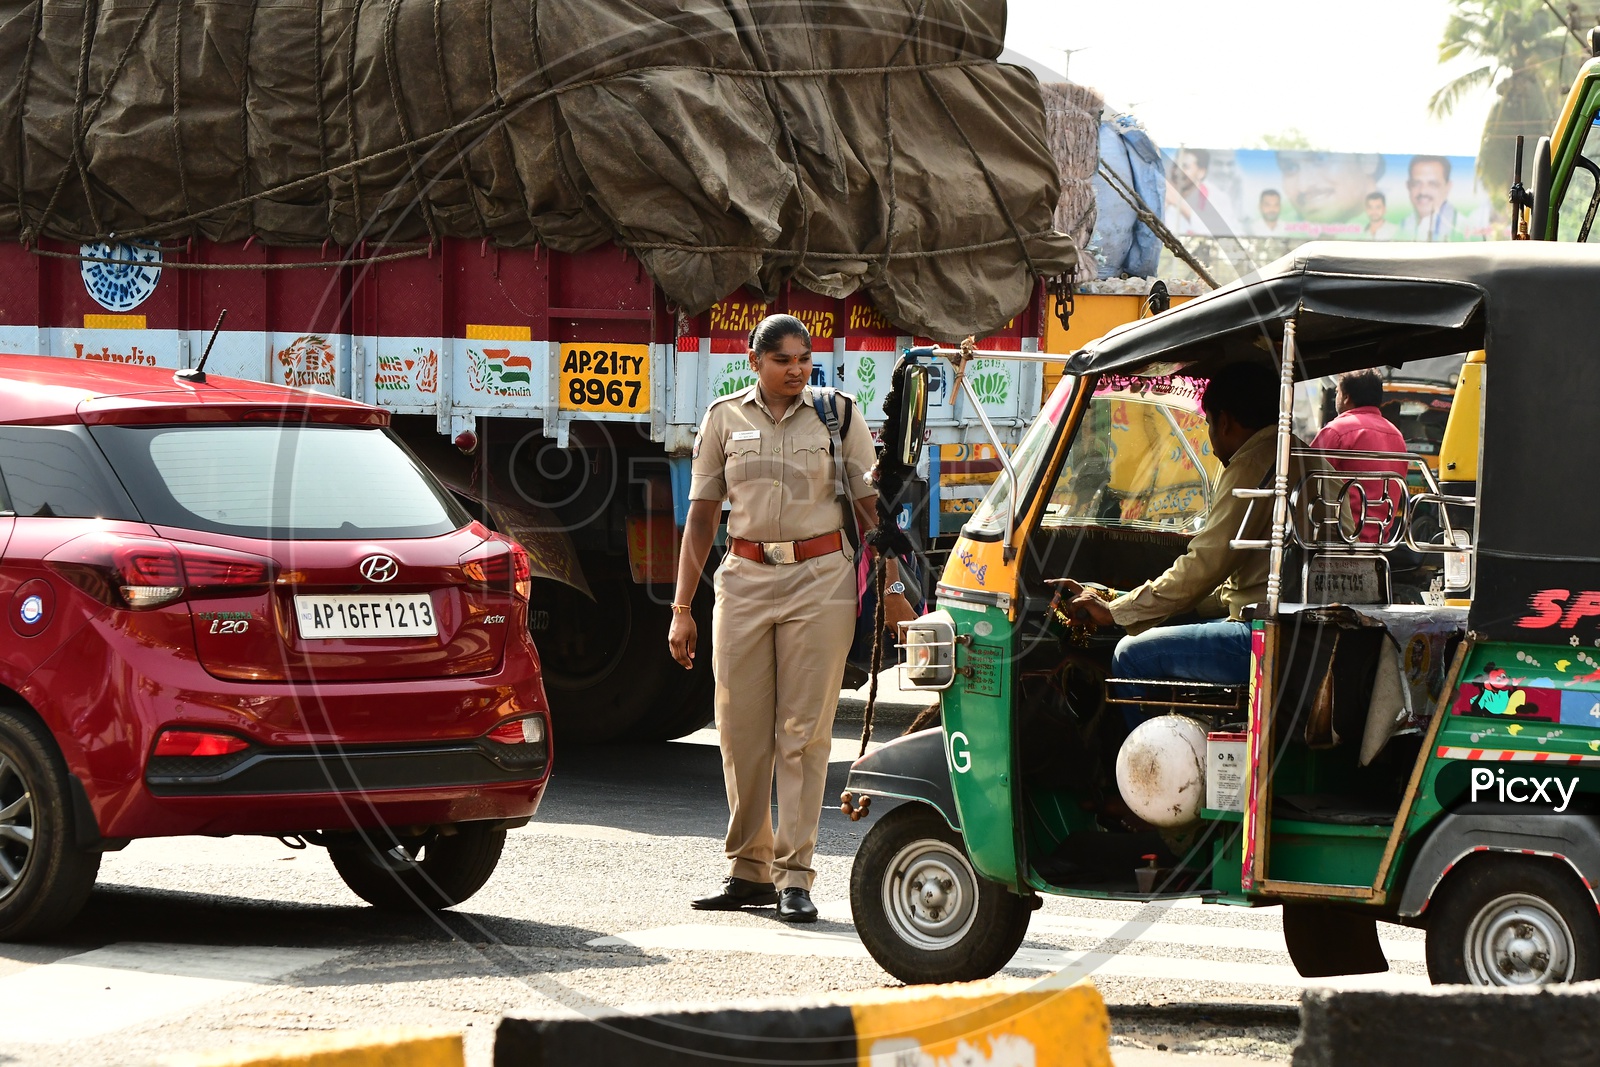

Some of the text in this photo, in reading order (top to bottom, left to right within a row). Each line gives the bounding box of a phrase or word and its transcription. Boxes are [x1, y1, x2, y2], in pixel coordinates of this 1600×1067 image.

[787, 309, 834, 339] UND
[296, 371, 331, 387] KINGS
[568, 377, 642, 408] 8967
[209, 619, 249, 634] i20
[313, 602, 433, 629] AP16FF1213
[946, 730, 972, 774] G
